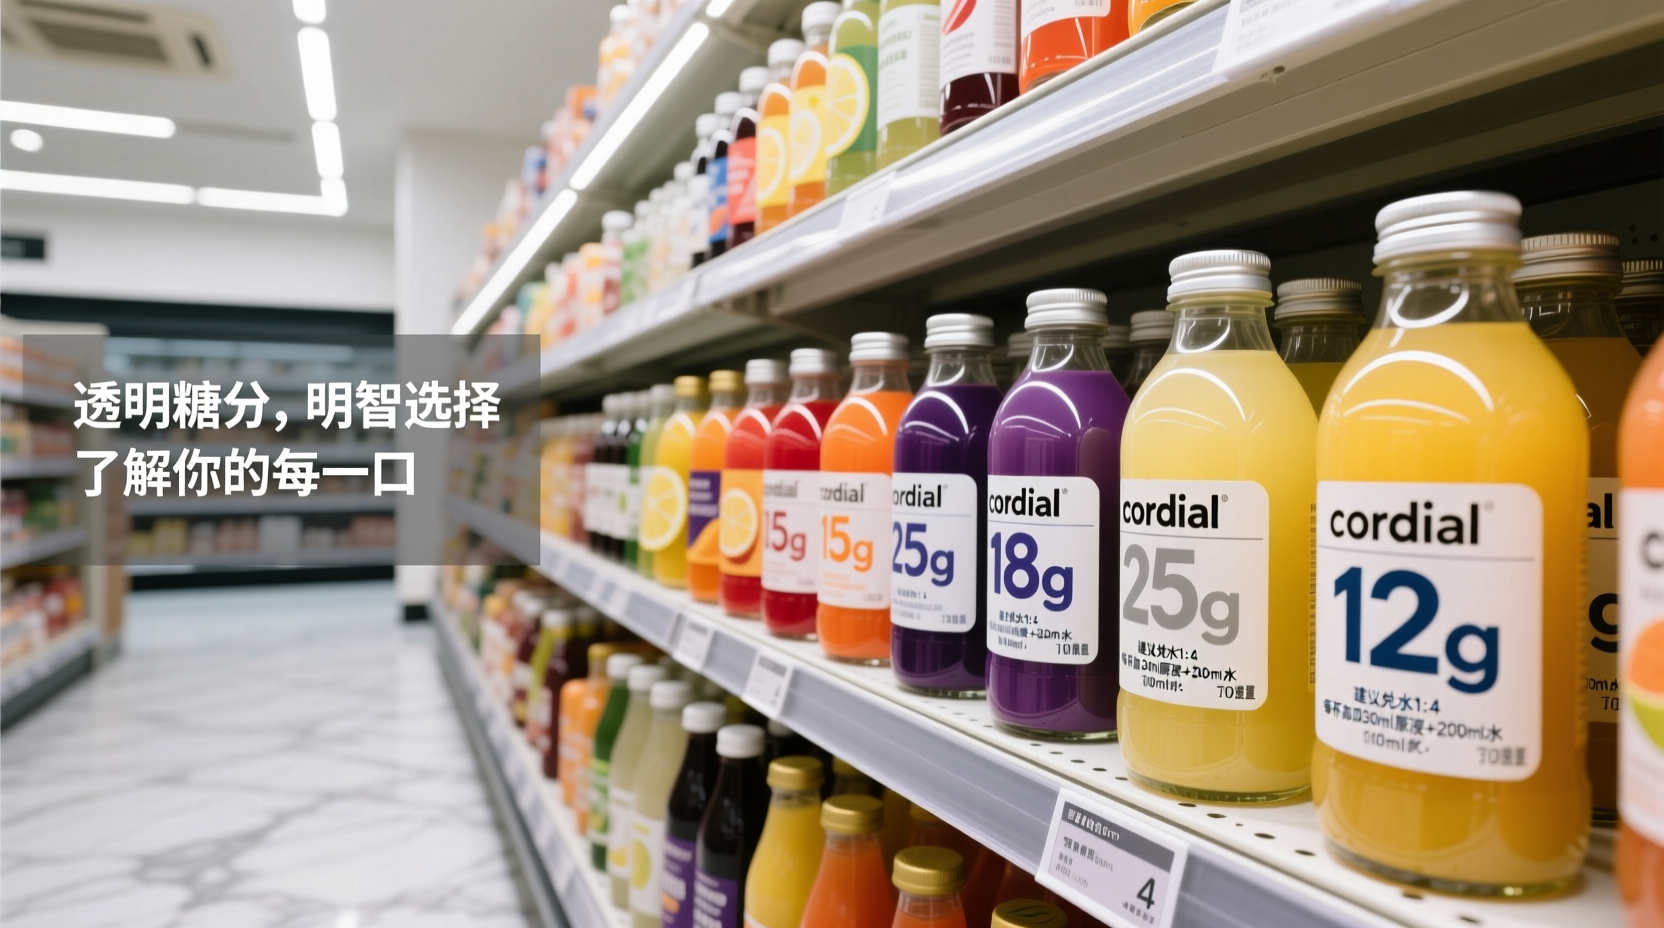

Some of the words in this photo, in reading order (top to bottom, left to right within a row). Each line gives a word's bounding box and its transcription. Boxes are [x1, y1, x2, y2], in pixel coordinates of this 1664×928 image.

[989, 488, 1060, 517] cordial
[1123, 494, 1219, 529] cordial
[1330, 501, 1479, 545] cordial
[821, 514, 874, 573] 15g
[892, 521, 955, 587] 25g
[990, 531, 1073, 612] 18g
[1123, 544, 1240, 646] 25g
[1334, 566, 1500, 694] 12g
[1136, 877, 1156, 910] 4
